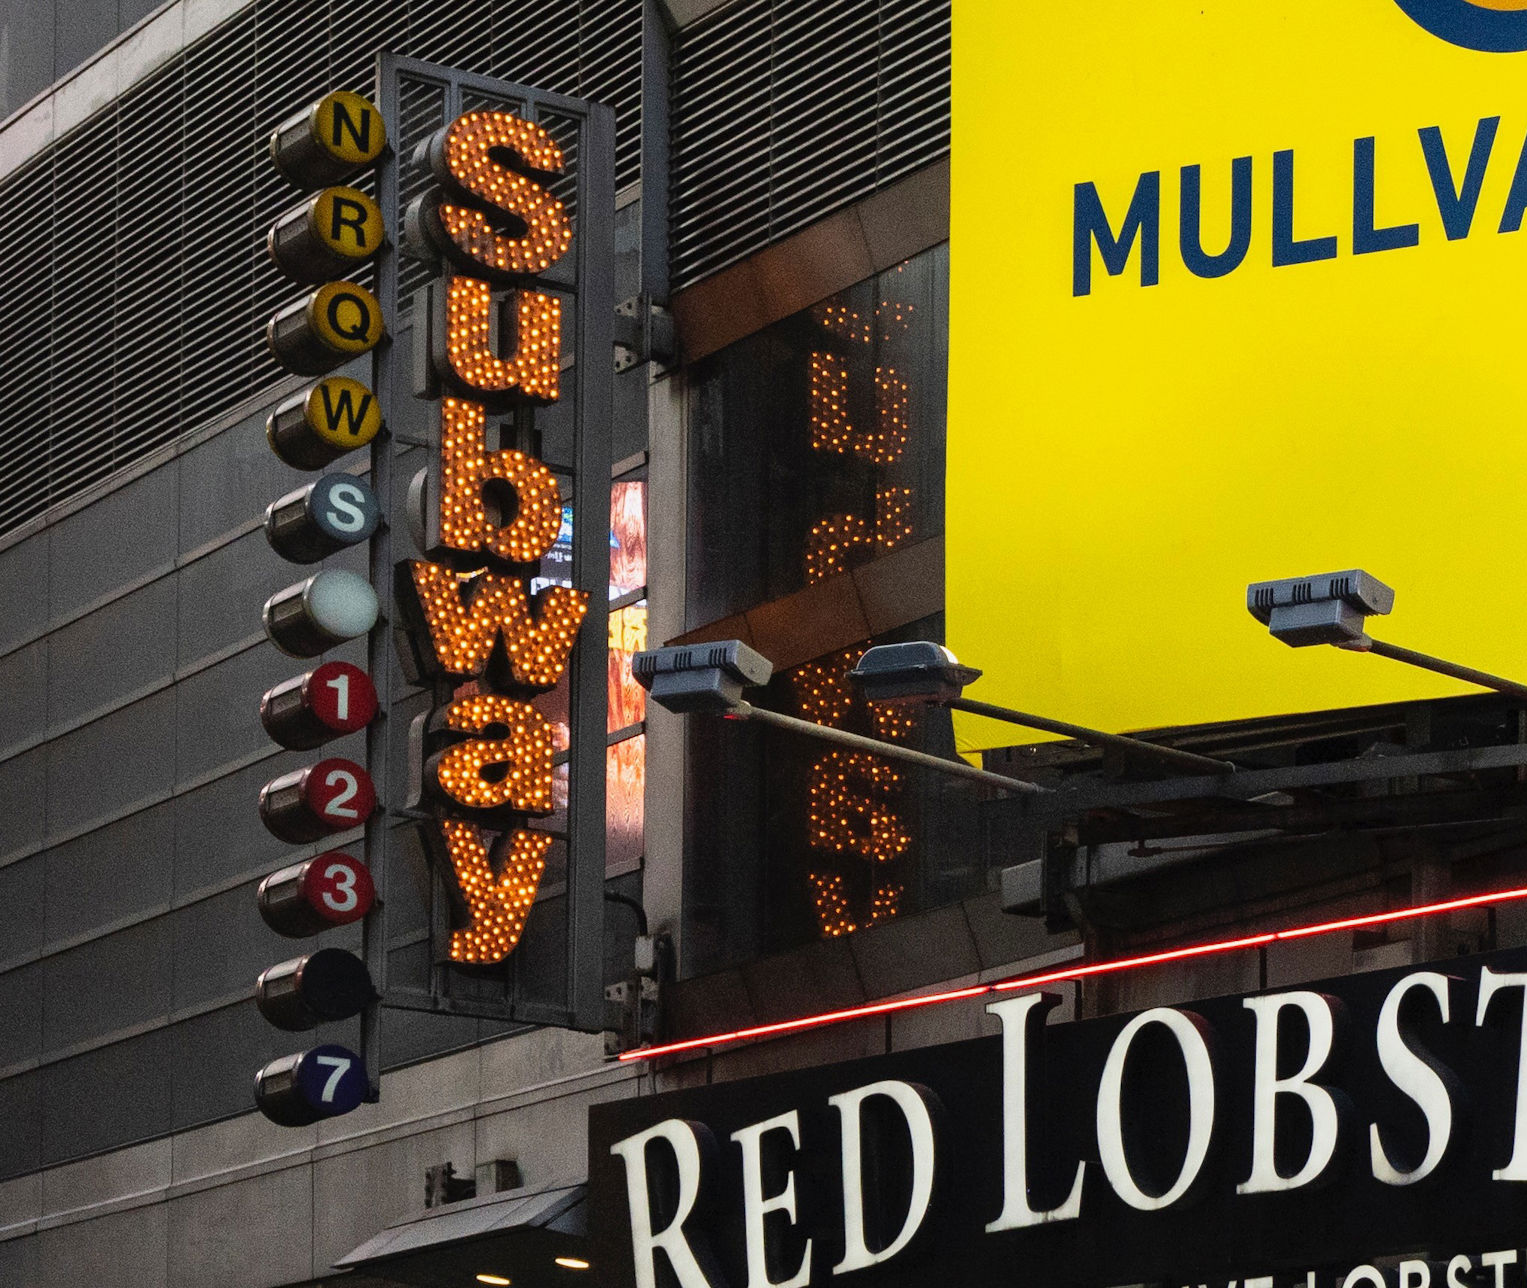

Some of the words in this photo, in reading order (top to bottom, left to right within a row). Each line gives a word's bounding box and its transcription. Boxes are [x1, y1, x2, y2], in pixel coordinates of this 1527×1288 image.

[332, 101, 371, 155] N
[330, 199, 367, 247] R
[326, 291, 370, 343] Q
[320, 388, 372, 437] W
[326, 481, 366, 535] S
[408, 110, 590, 964] Subway
[326, 673, 351, 721] 1
[323, 768, 360, 815] 2
[322, 862, 359, 911] 3
[316, 1056, 352, 1103] 7
